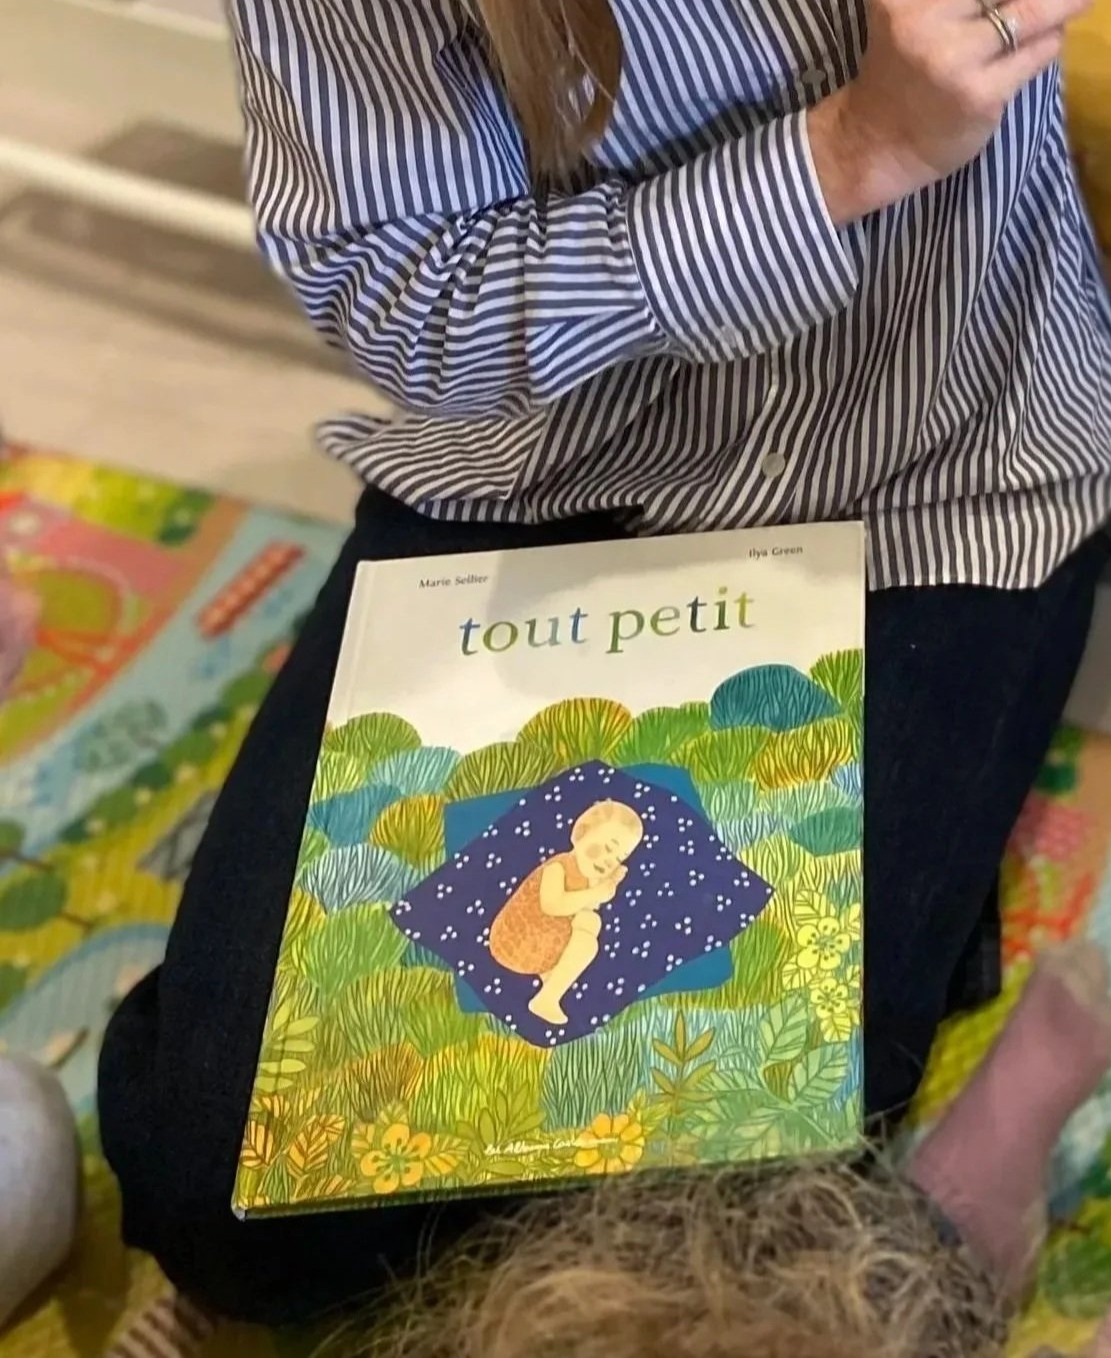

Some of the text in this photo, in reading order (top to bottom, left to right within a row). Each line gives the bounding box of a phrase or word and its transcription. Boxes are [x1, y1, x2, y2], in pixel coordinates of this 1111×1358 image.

[748, 545, 803, 560] Ilya Green
[419, 573, 488, 588] Marie Sellier
[458, 586, 755, 656] tout petit
